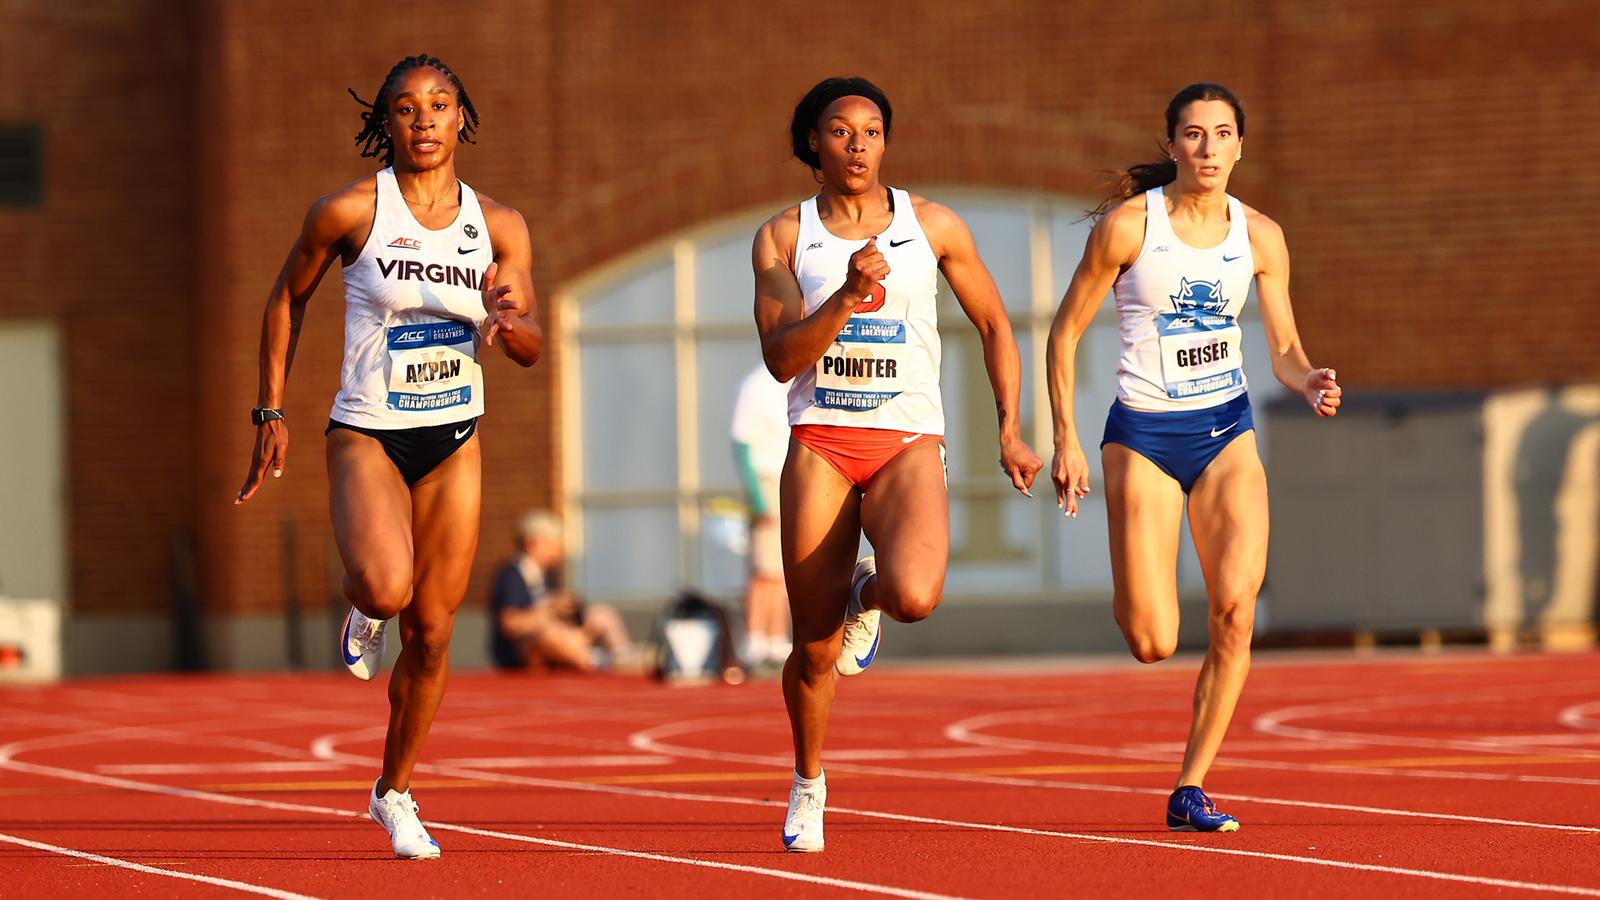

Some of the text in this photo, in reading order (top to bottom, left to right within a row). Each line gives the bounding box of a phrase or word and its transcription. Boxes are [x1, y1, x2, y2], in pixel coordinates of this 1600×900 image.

[389, 237, 423, 250] ACC
[804, 241, 824, 251] ACC
[375, 257, 485, 292] VIRGINI
[1167, 317, 1197, 329] ACC
[395, 330, 426, 342] ACC
[433, 329, 465, 340] GREATNESS
[1176, 341, 1229, 368] GEISER
[405, 359, 461, 383] AKPAN
[823, 355, 897, 378] POINTER
[398, 395, 461, 409] CHAMPIONSHIPS
